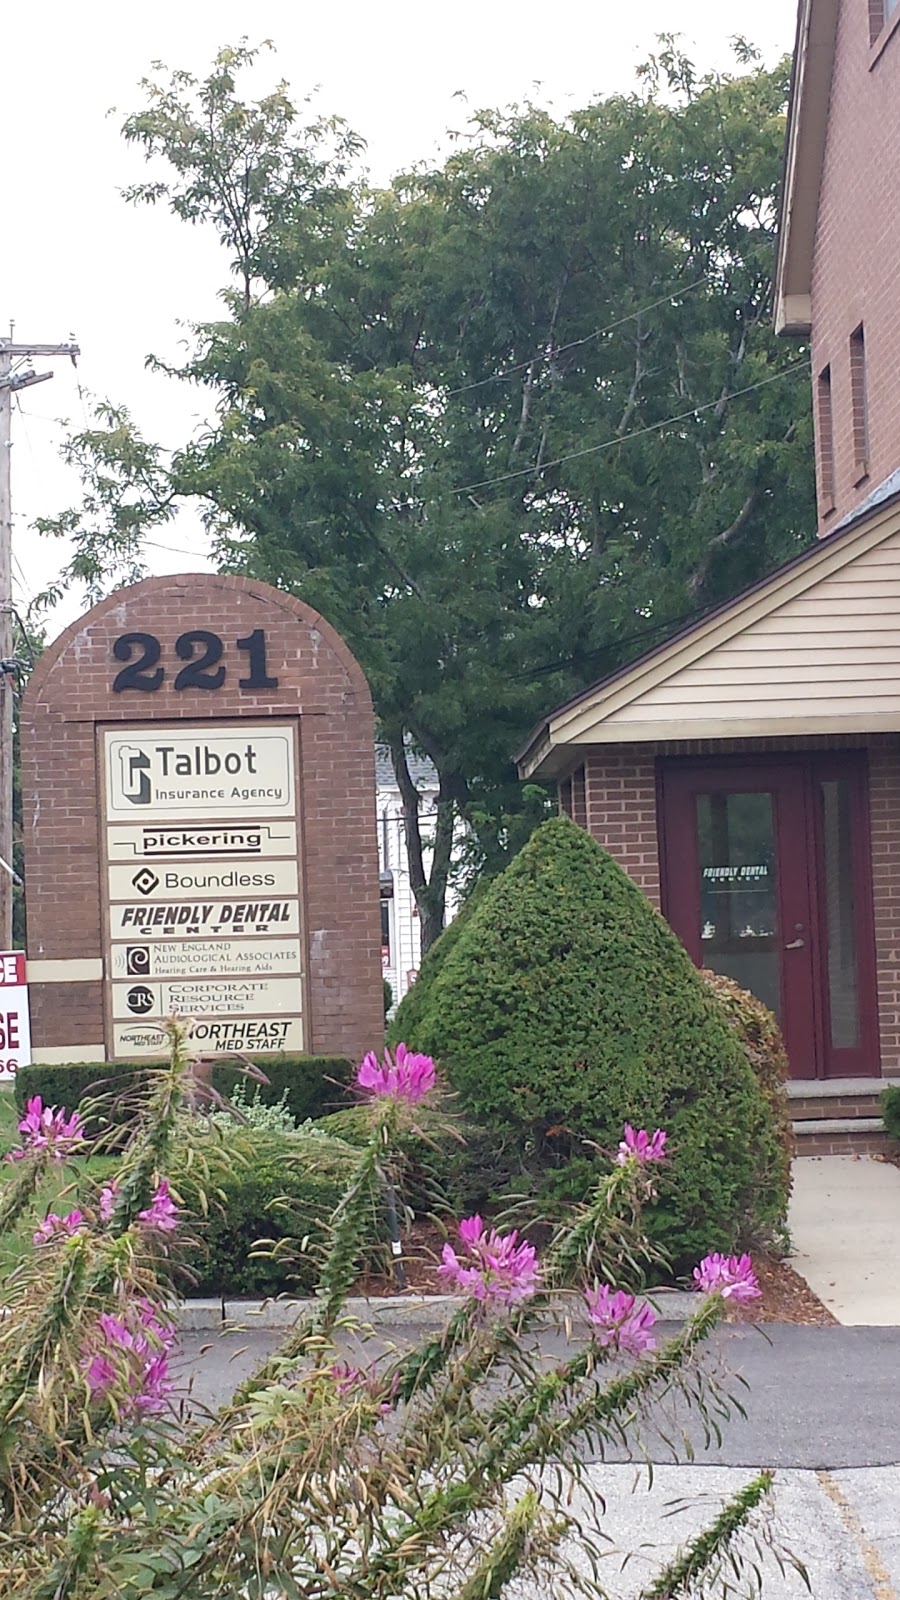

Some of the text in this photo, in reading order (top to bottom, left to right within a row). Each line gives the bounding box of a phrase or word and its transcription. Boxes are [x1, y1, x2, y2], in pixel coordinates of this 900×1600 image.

[113, 629, 278, 693] 221
[155, 745, 257, 776] Talbot
[156, 787, 282, 800] Insurance Agency
[143, 833, 261, 849] pickering
[165, 872, 275, 888] Boundless
[121, 903, 291, 927] FRIENDLY DENTAL
[140, 924, 269, 935] CENTER
[153, 943, 231, 953] NEW ENGLAND
[153, 951, 297, 964] AUDIOLOGICAL ASSOCIATES
[155, 966, 186, 975] Hearing
[189, 965, 207, 973] Care
[220, 964, 251, 973] Hearing
[255, 963, 273, 971] Aids
[168, 983, 268, 993] CORPORATE
[127, 992, 155, 1007] CRS
[169, 993, 254, 1003] RESOURCE
[169, 1003, 245, 1013] SERVICES
[215, 1038, 286, 1051] MED STAFF
